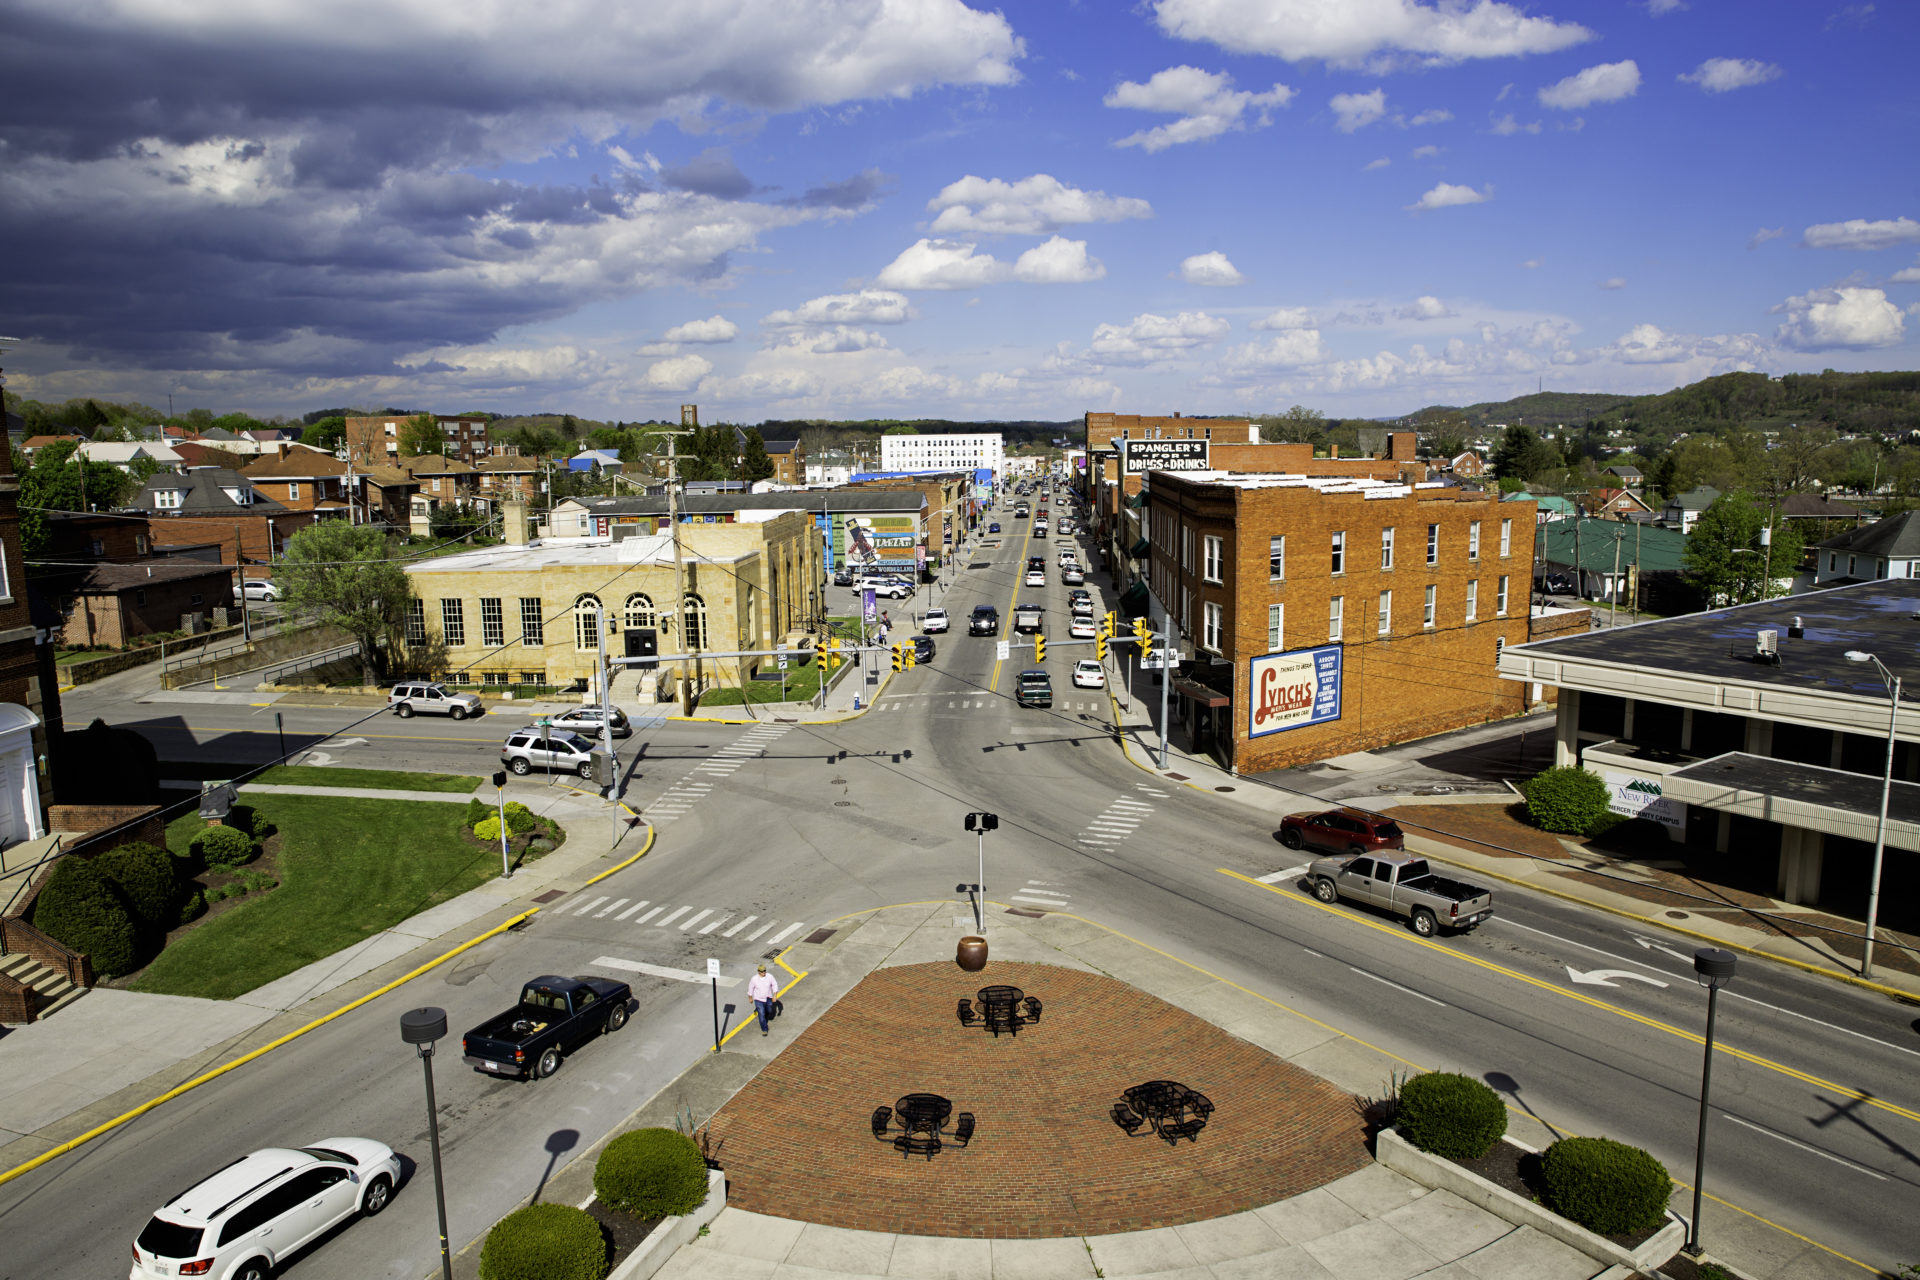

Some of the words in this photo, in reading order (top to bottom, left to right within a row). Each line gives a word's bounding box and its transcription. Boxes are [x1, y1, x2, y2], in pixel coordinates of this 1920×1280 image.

[1131, 444, 1201, 452] SPANGLER'S
[1129, 459, 1163, 470] DRUGS
[1170, 459, 1206, 469] DRINKS
[1608, 804, 1631, 814] MERCER
[1632, 810, 1654, 819] COUNTY
[1656, 814, 1680, 825] CAMPUS
